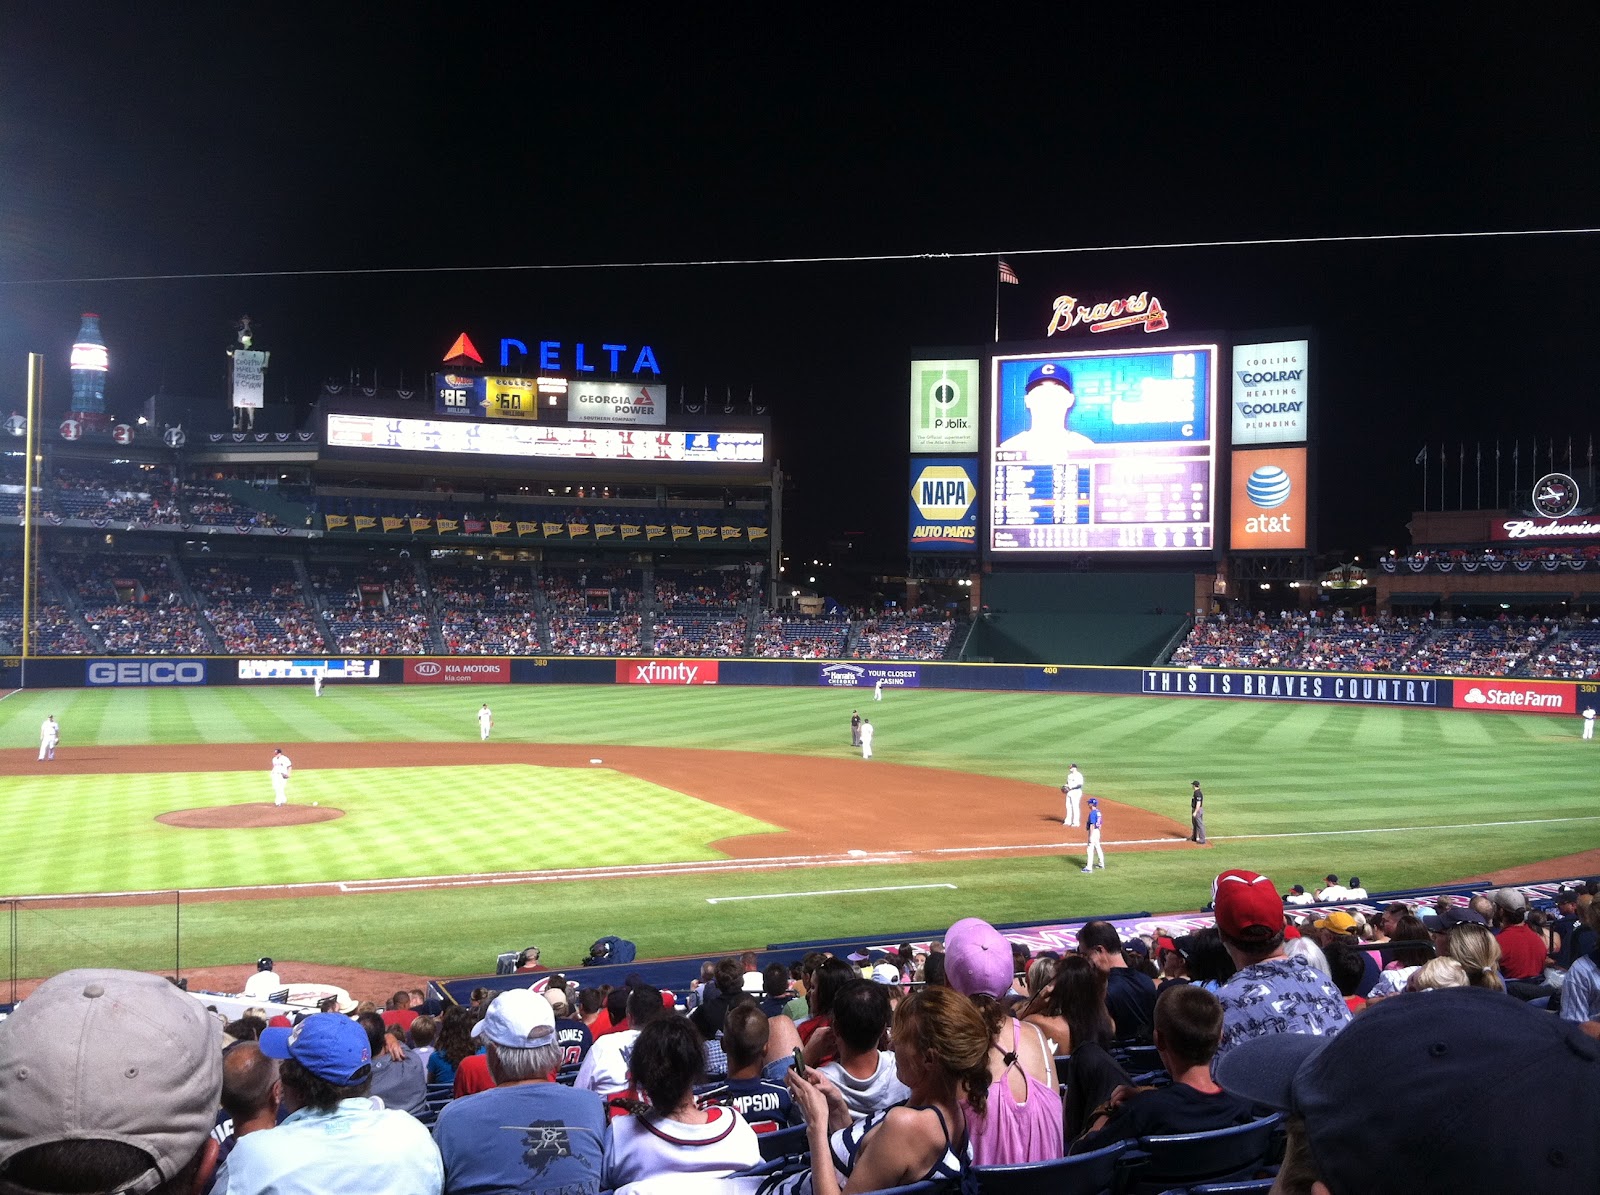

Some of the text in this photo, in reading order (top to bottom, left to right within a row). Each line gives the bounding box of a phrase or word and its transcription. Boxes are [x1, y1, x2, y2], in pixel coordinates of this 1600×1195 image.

[1047, 291, 1149, 337] Braves
[501, 338, 660, 374] DELTA
[1246, 356, 1297, 366] COOLING
[1242, 369, 1304, 383] COOLRAY
[579, 395, 631, 405] GEORGIA
[1246, 388, 1297, 397] HEATING
[614, 406, 654, 415] POWER
[1242, 401, 1303, 415] COOLRAY
[60, 423, 81, 439] 41
[1246, 420, 1297, 428] PLUMBING
[113, 426, 134, 441] 21
[922, 481, 966, 505] NAPA
[1244, 513, 1292, 533] at&t
[912, 526, 976, 538] AUTO PARTS
[3, 660, 20, 668] 335
[445, 665, 500, 673] KIA MOTORS
[89, 662, 204, 684] GEICO
[636, 661, 698, 684] xfinity
[1149, 672, 1429, 702] THIS IS BRAVES COUNTRY
[558, 1028, 584, 1043] JONES
[732, 1092, 780, 1114] MPSON
